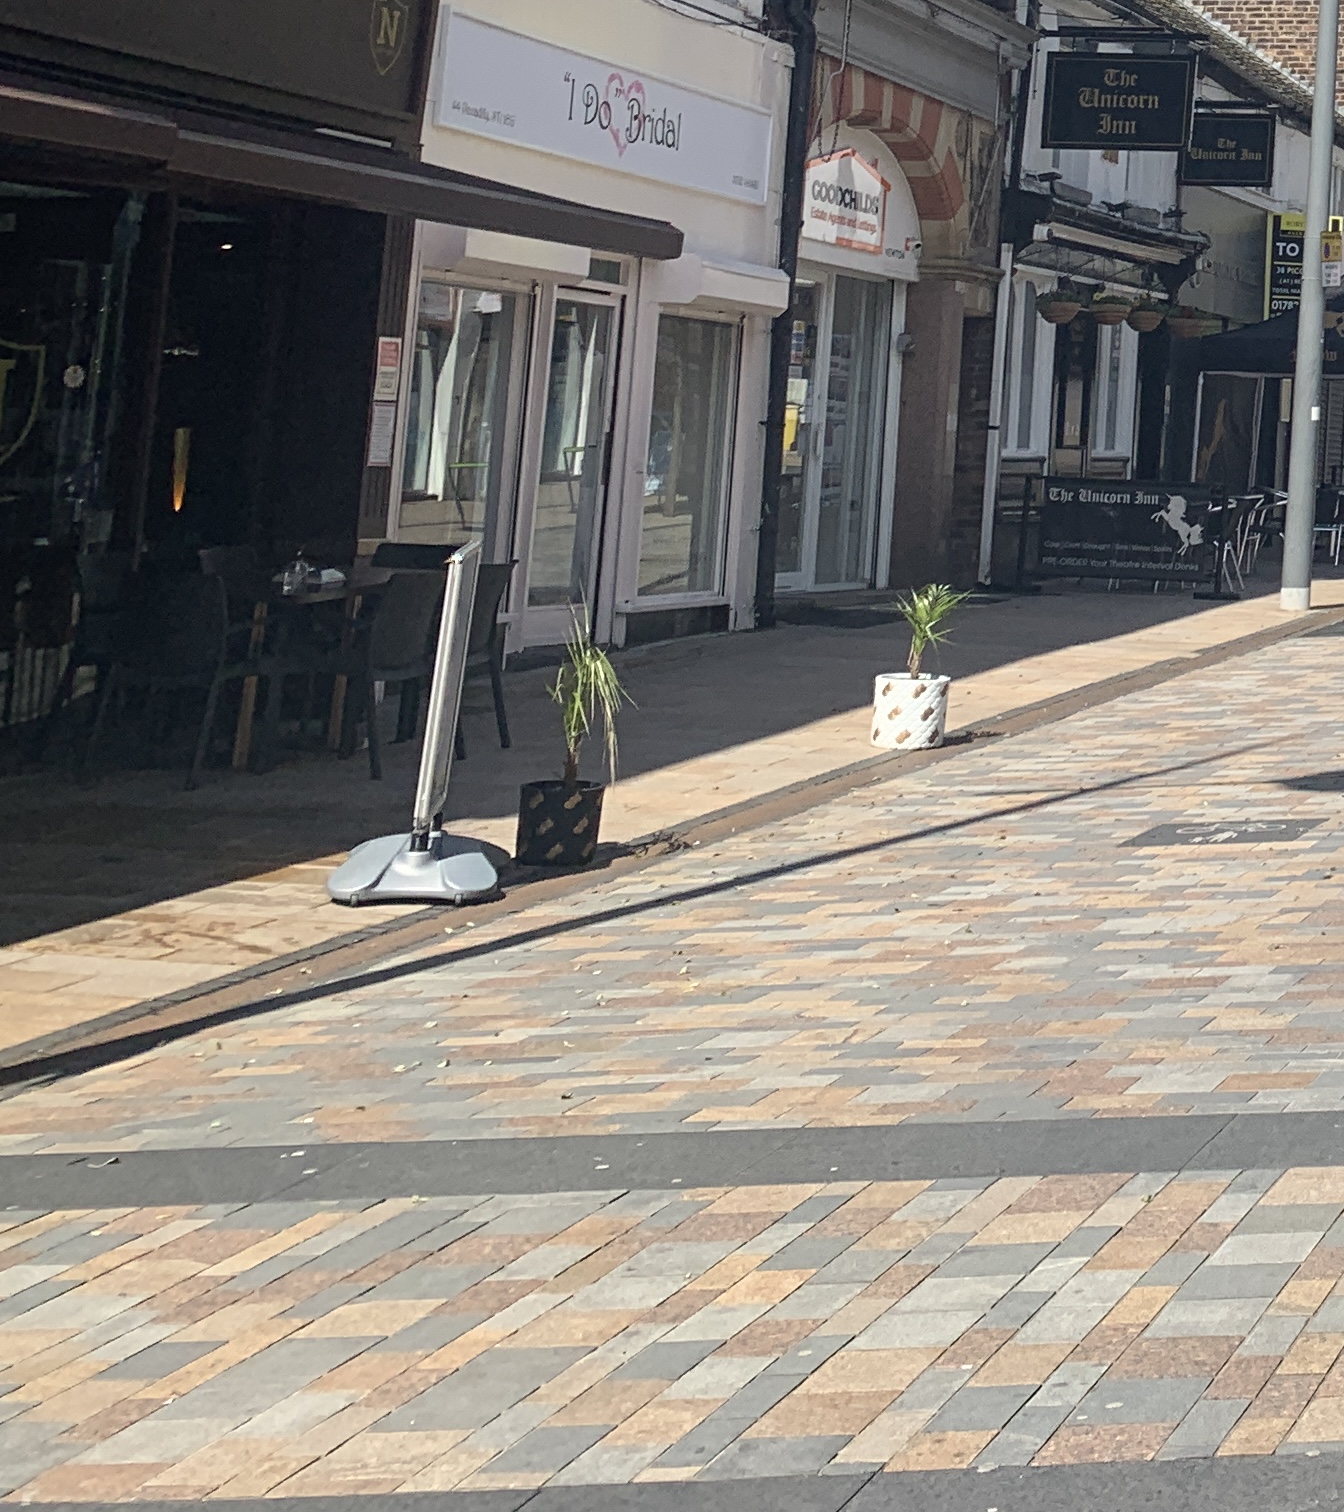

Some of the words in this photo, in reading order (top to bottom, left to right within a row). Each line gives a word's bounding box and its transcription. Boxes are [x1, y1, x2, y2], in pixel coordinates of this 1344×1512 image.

[1103, 68, 1138, 88] The
[1078, 87, 1160, 110] Unicorn
[625, 97, 682, 152] Bridal
[1097, 113, 1137, 135] Inn
[1216, 137, 1237, 149] The
[1190, 149, 1236, 161] Unicorn
[1240, 149, 1263, 161] Inn
[811, 179, 879, 216] GOODCHILDS
[1276, 242, 1300, 257] TO
[1048, 486, 1074, 503] The
[1079, 489, 1131, 504] Unicorn
[1134, 491, 1160, 505] Inn
